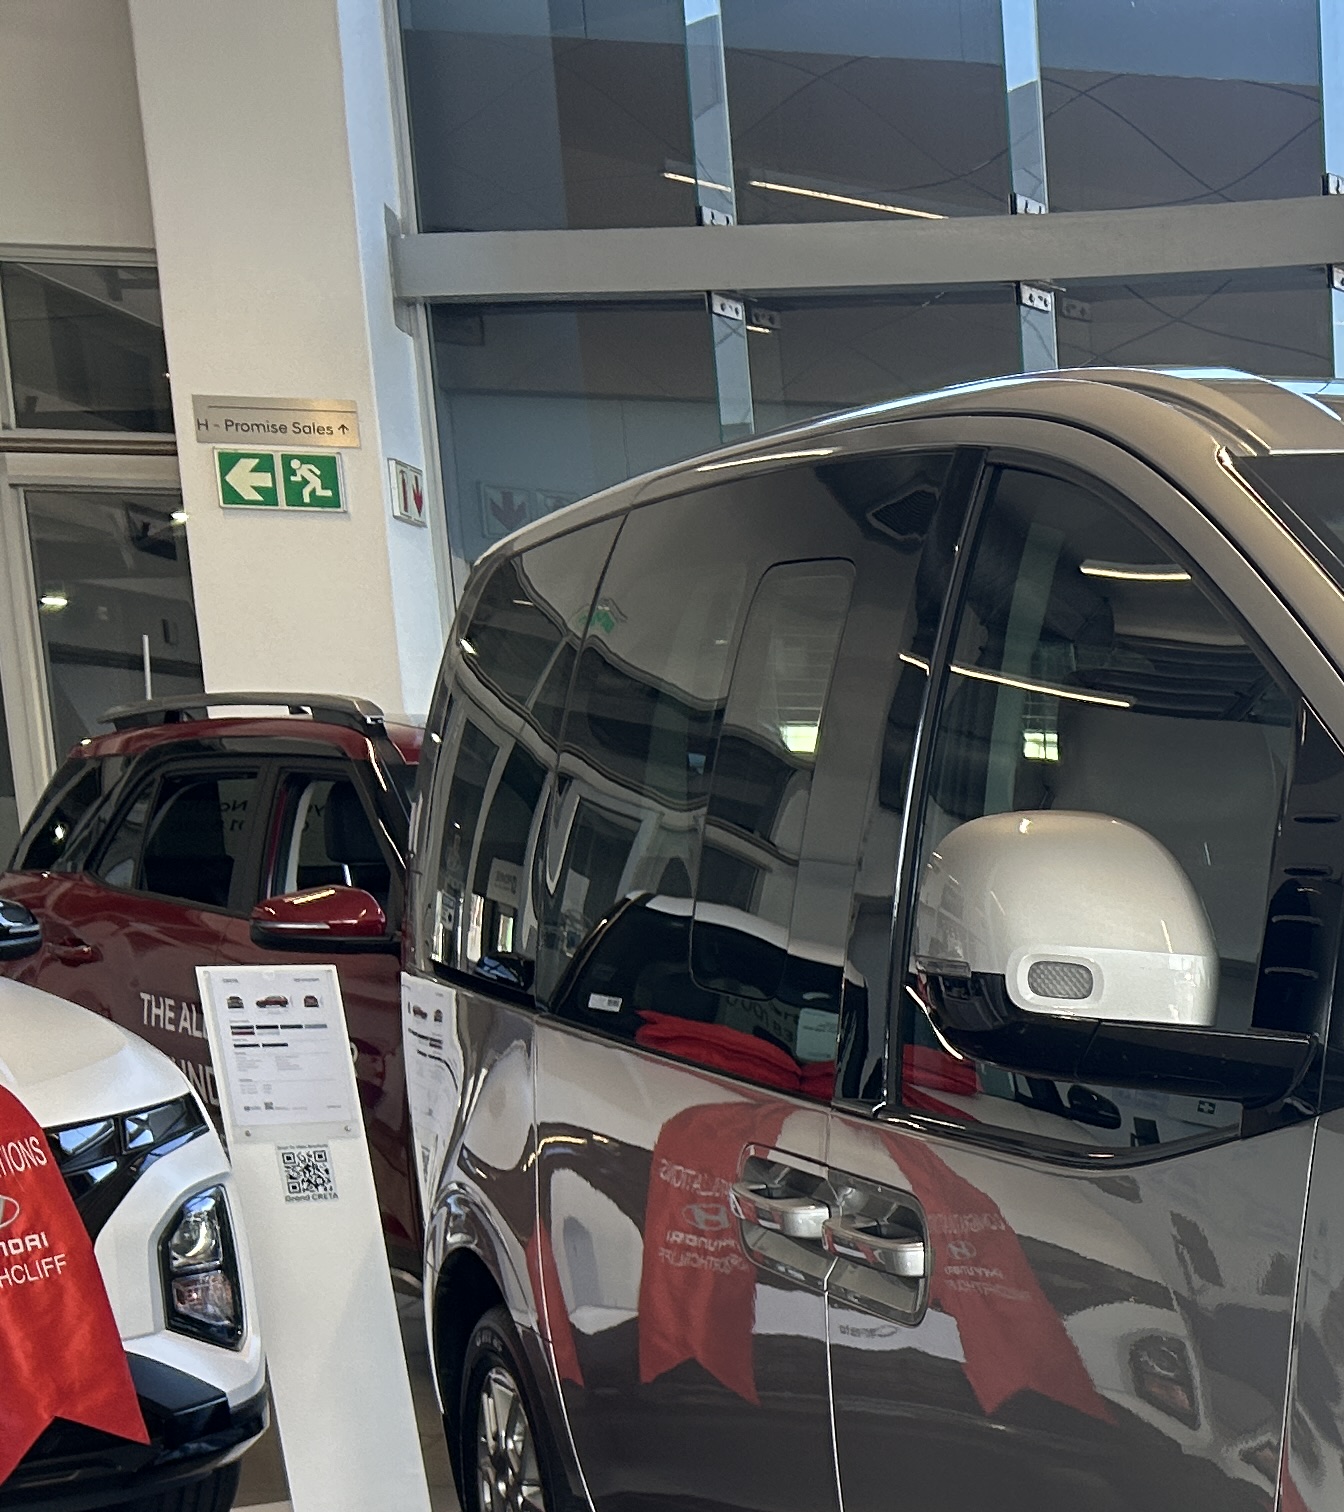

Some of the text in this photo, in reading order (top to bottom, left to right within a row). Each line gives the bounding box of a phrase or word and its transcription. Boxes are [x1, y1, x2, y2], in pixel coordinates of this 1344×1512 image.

[197, 418, 209, 431] H
[224, 418, 288, 434] Promise
[291, 421, 334, 436] Sales
[139, 991, 176, 1029] THE
[311, 1192, 339, 1201] CRETA
